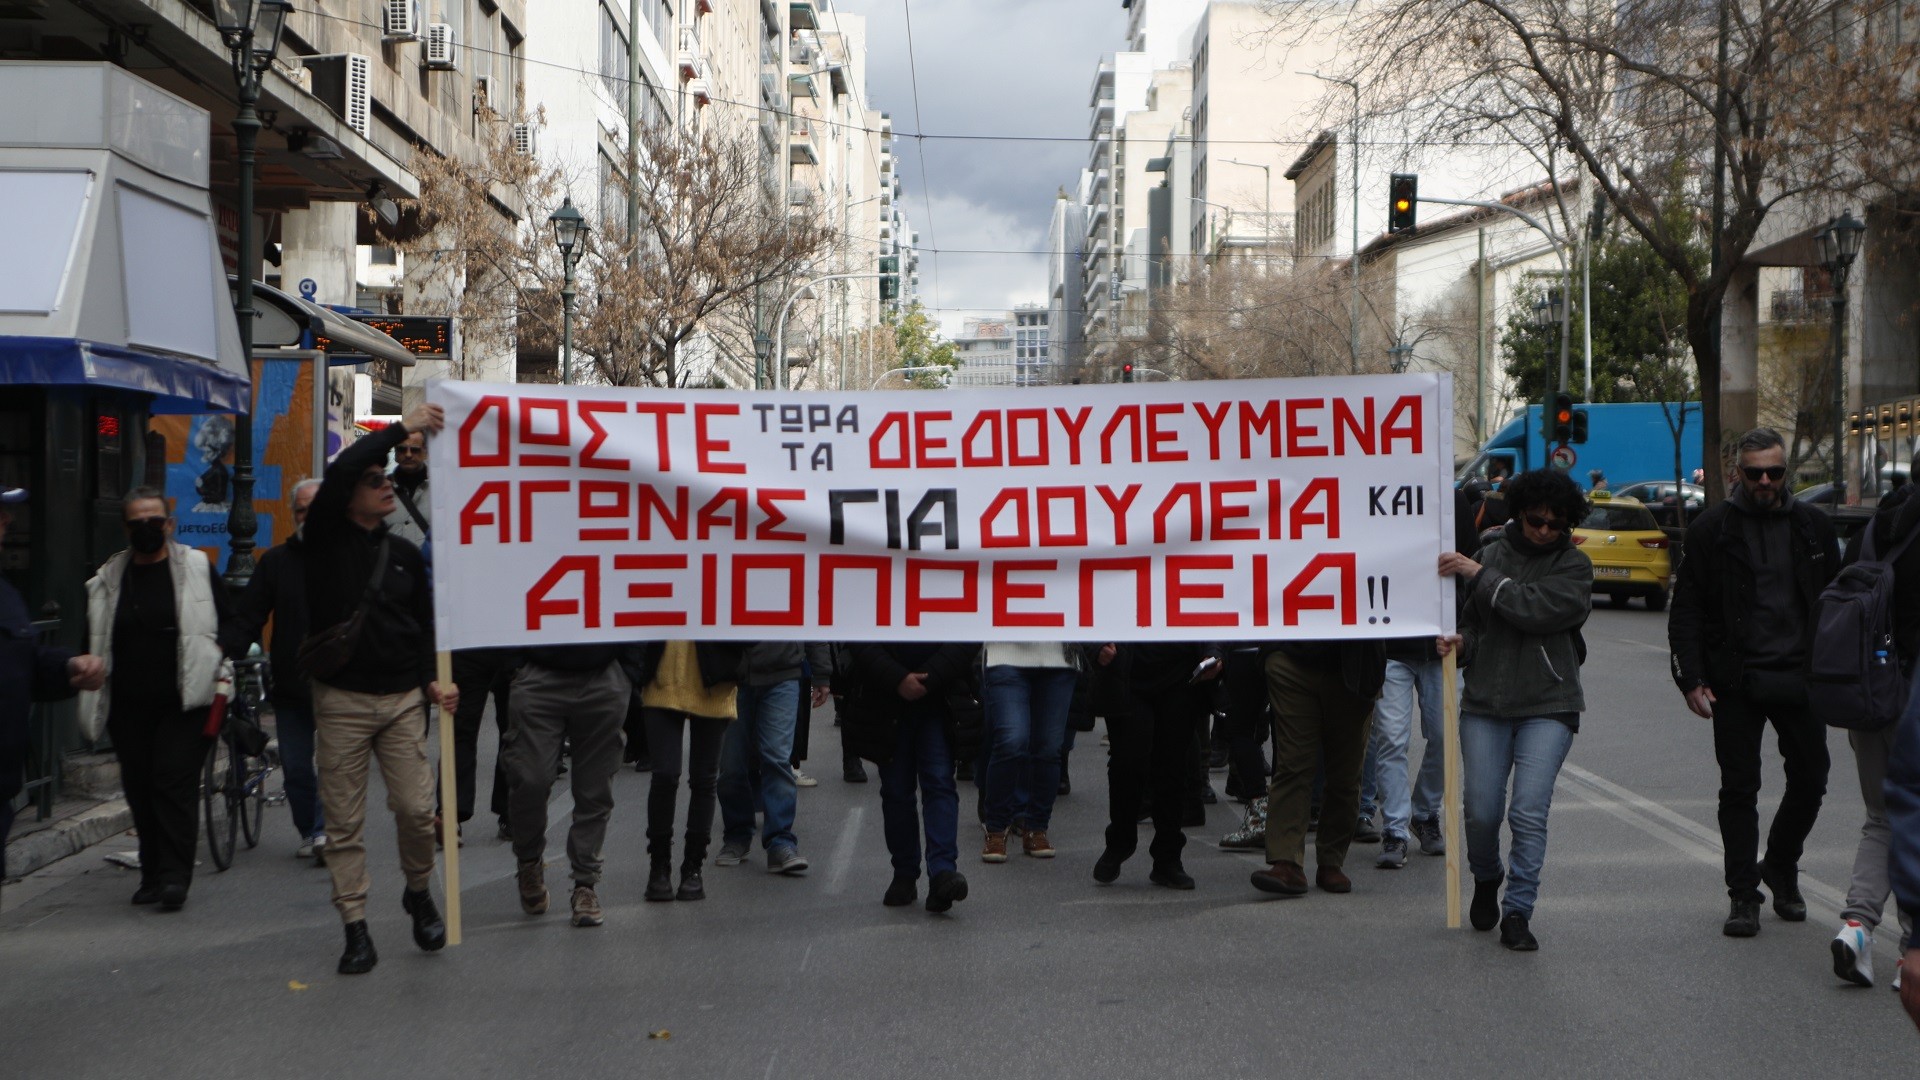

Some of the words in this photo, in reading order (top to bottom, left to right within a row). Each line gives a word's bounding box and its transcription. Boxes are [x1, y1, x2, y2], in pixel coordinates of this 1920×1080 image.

[459, 395, 747, 474] ΔΩΣΤΕ
[753, 404, 859, 434] ΤΩΡΑ
[869, 395, 1422, 468] ΔΕΔΟΥΛΕΥΜΕΝΑ
[782, 442, 833, 471] ΤΑ
[178, 522, 227, 535] μετοΕθ
[460, 480, 807, 544] ΑΓΩΝΑΣ
[828, 488, 959, 550] ΓΙΑ
[980, 477, 1340, 547] ΔΟΥΛΕΙΑ
[1369, 485, 1423, 516] ΚΑΙ
